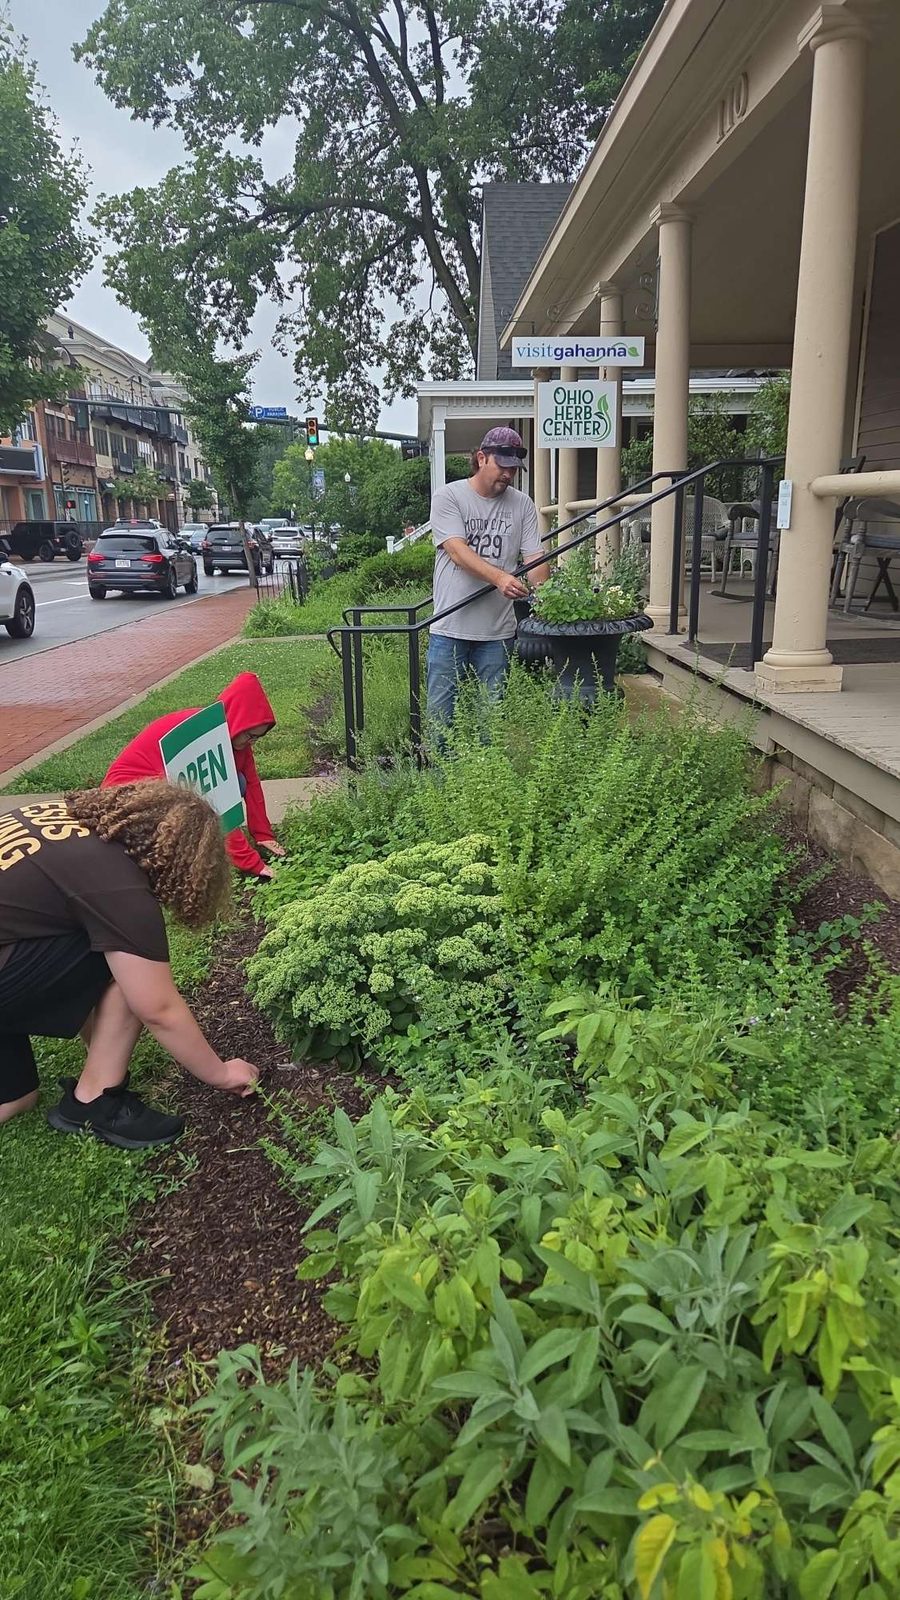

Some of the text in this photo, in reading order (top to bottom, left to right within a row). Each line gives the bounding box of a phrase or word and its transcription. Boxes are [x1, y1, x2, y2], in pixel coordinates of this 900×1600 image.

[716, 72, 749, 145] 110
[553, 386, 594, 405] OHIO
[554, 405, 593, 421] HERB
[542, 418, 601, 437] CENTER
[491, 518, 512, 534] CITY
[177, 743, 228, 795] OPEN
[20, 799, 91, 841] ESUS
